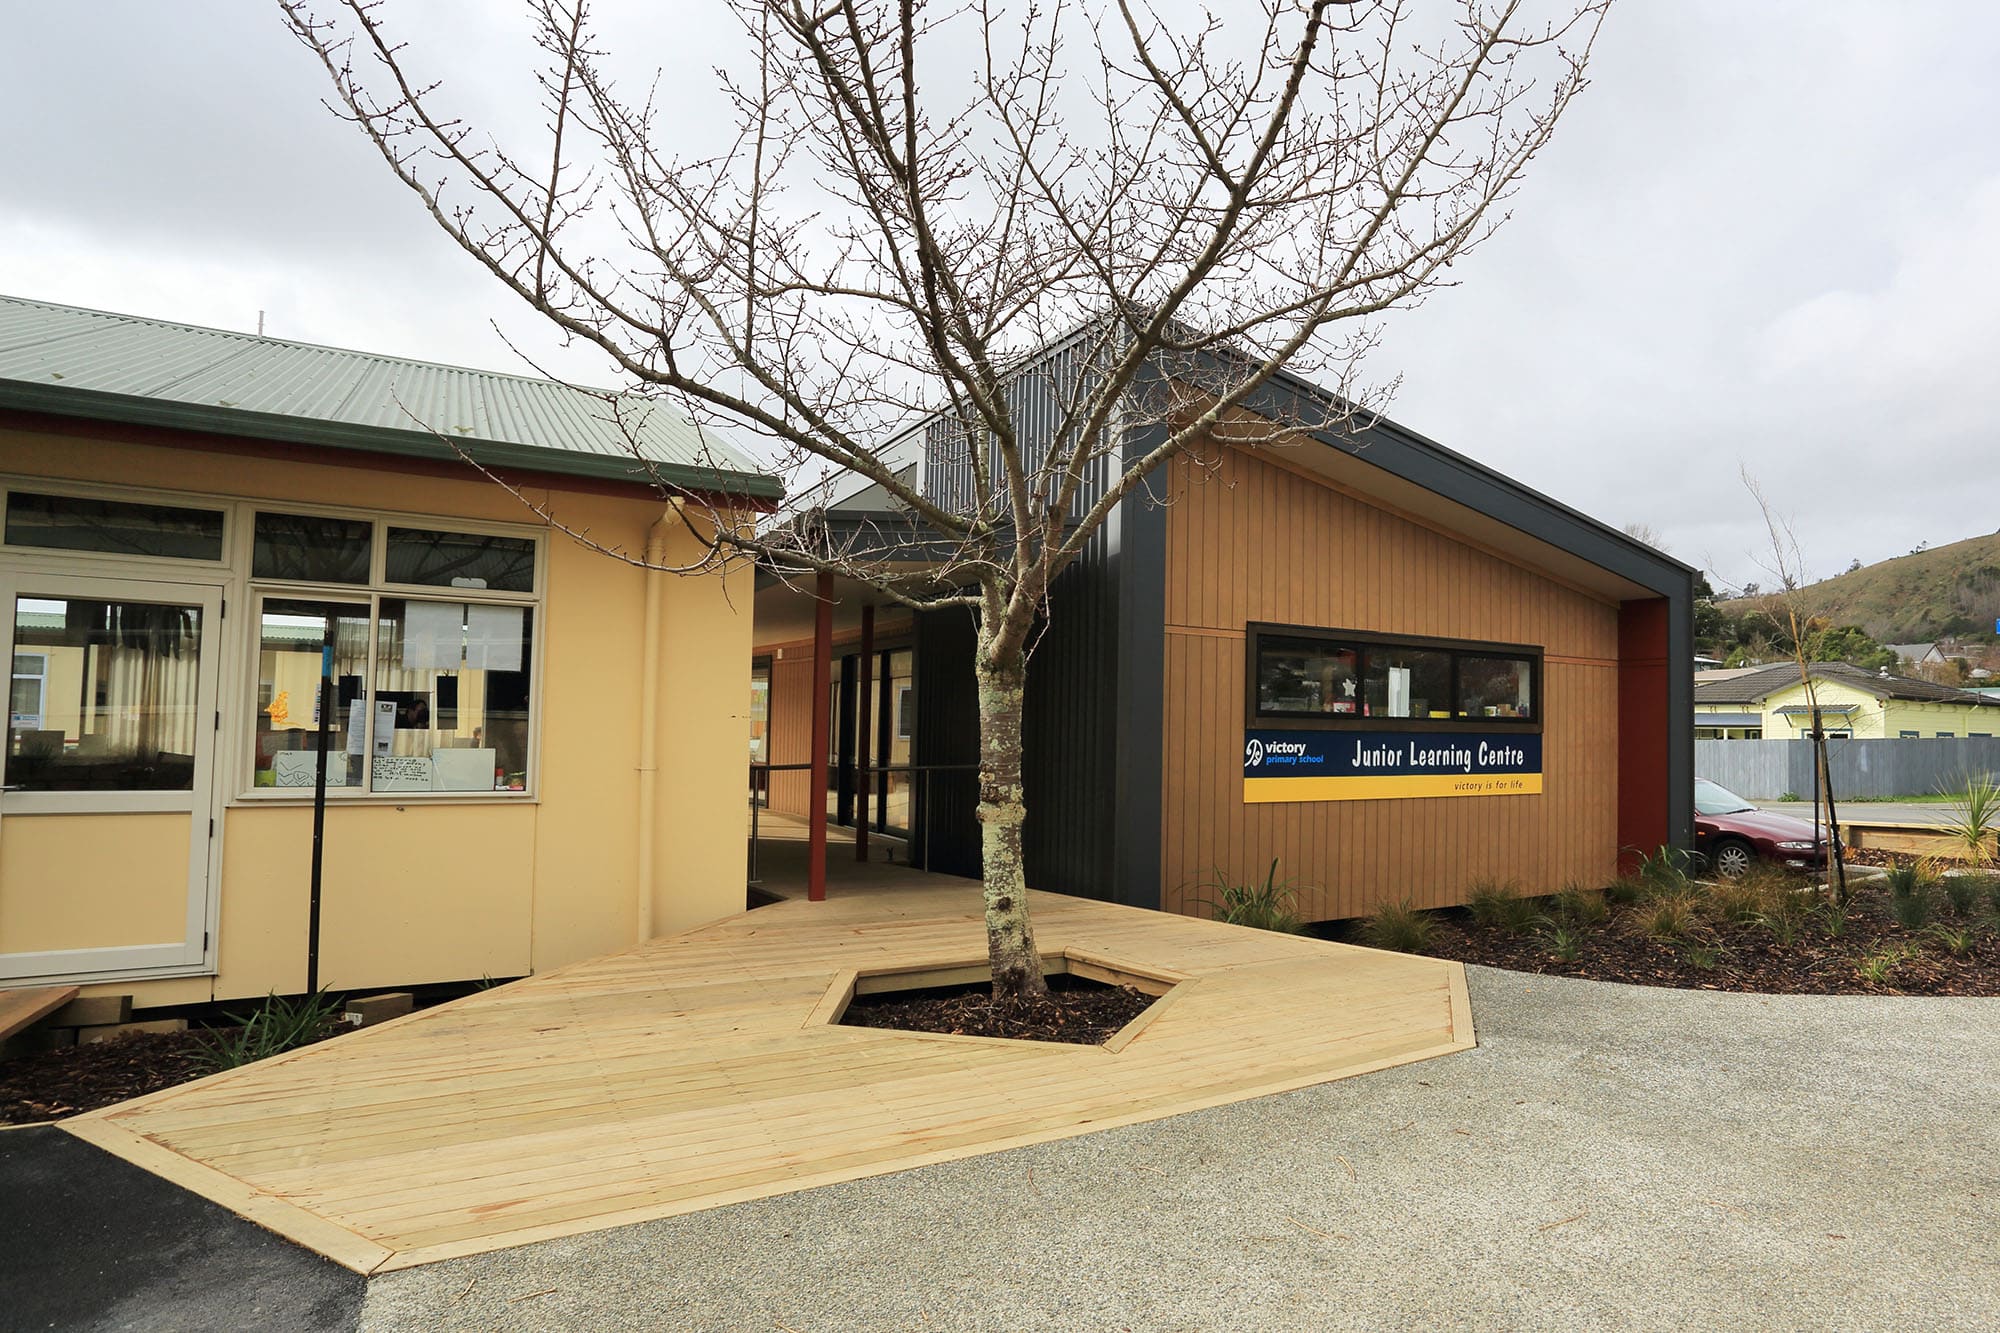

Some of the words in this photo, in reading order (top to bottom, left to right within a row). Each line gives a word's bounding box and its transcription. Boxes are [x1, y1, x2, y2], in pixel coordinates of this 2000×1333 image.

[1265, 741, 1306, 756] victory
[1266, 754, 1297, 766] primary
[1298, 754, 1324, 763] school
[1352, 739, 1402, 767] Junior
[1410, 741, 1471, 773] Learning
[1478, 740, 1524, 766] Centre
[1454, 781, 1482, 792] victory
[1486, 780, 1492, 789] is
[1495, 780, 1507, 789] for
[1510, 779, 1523, 789] life
